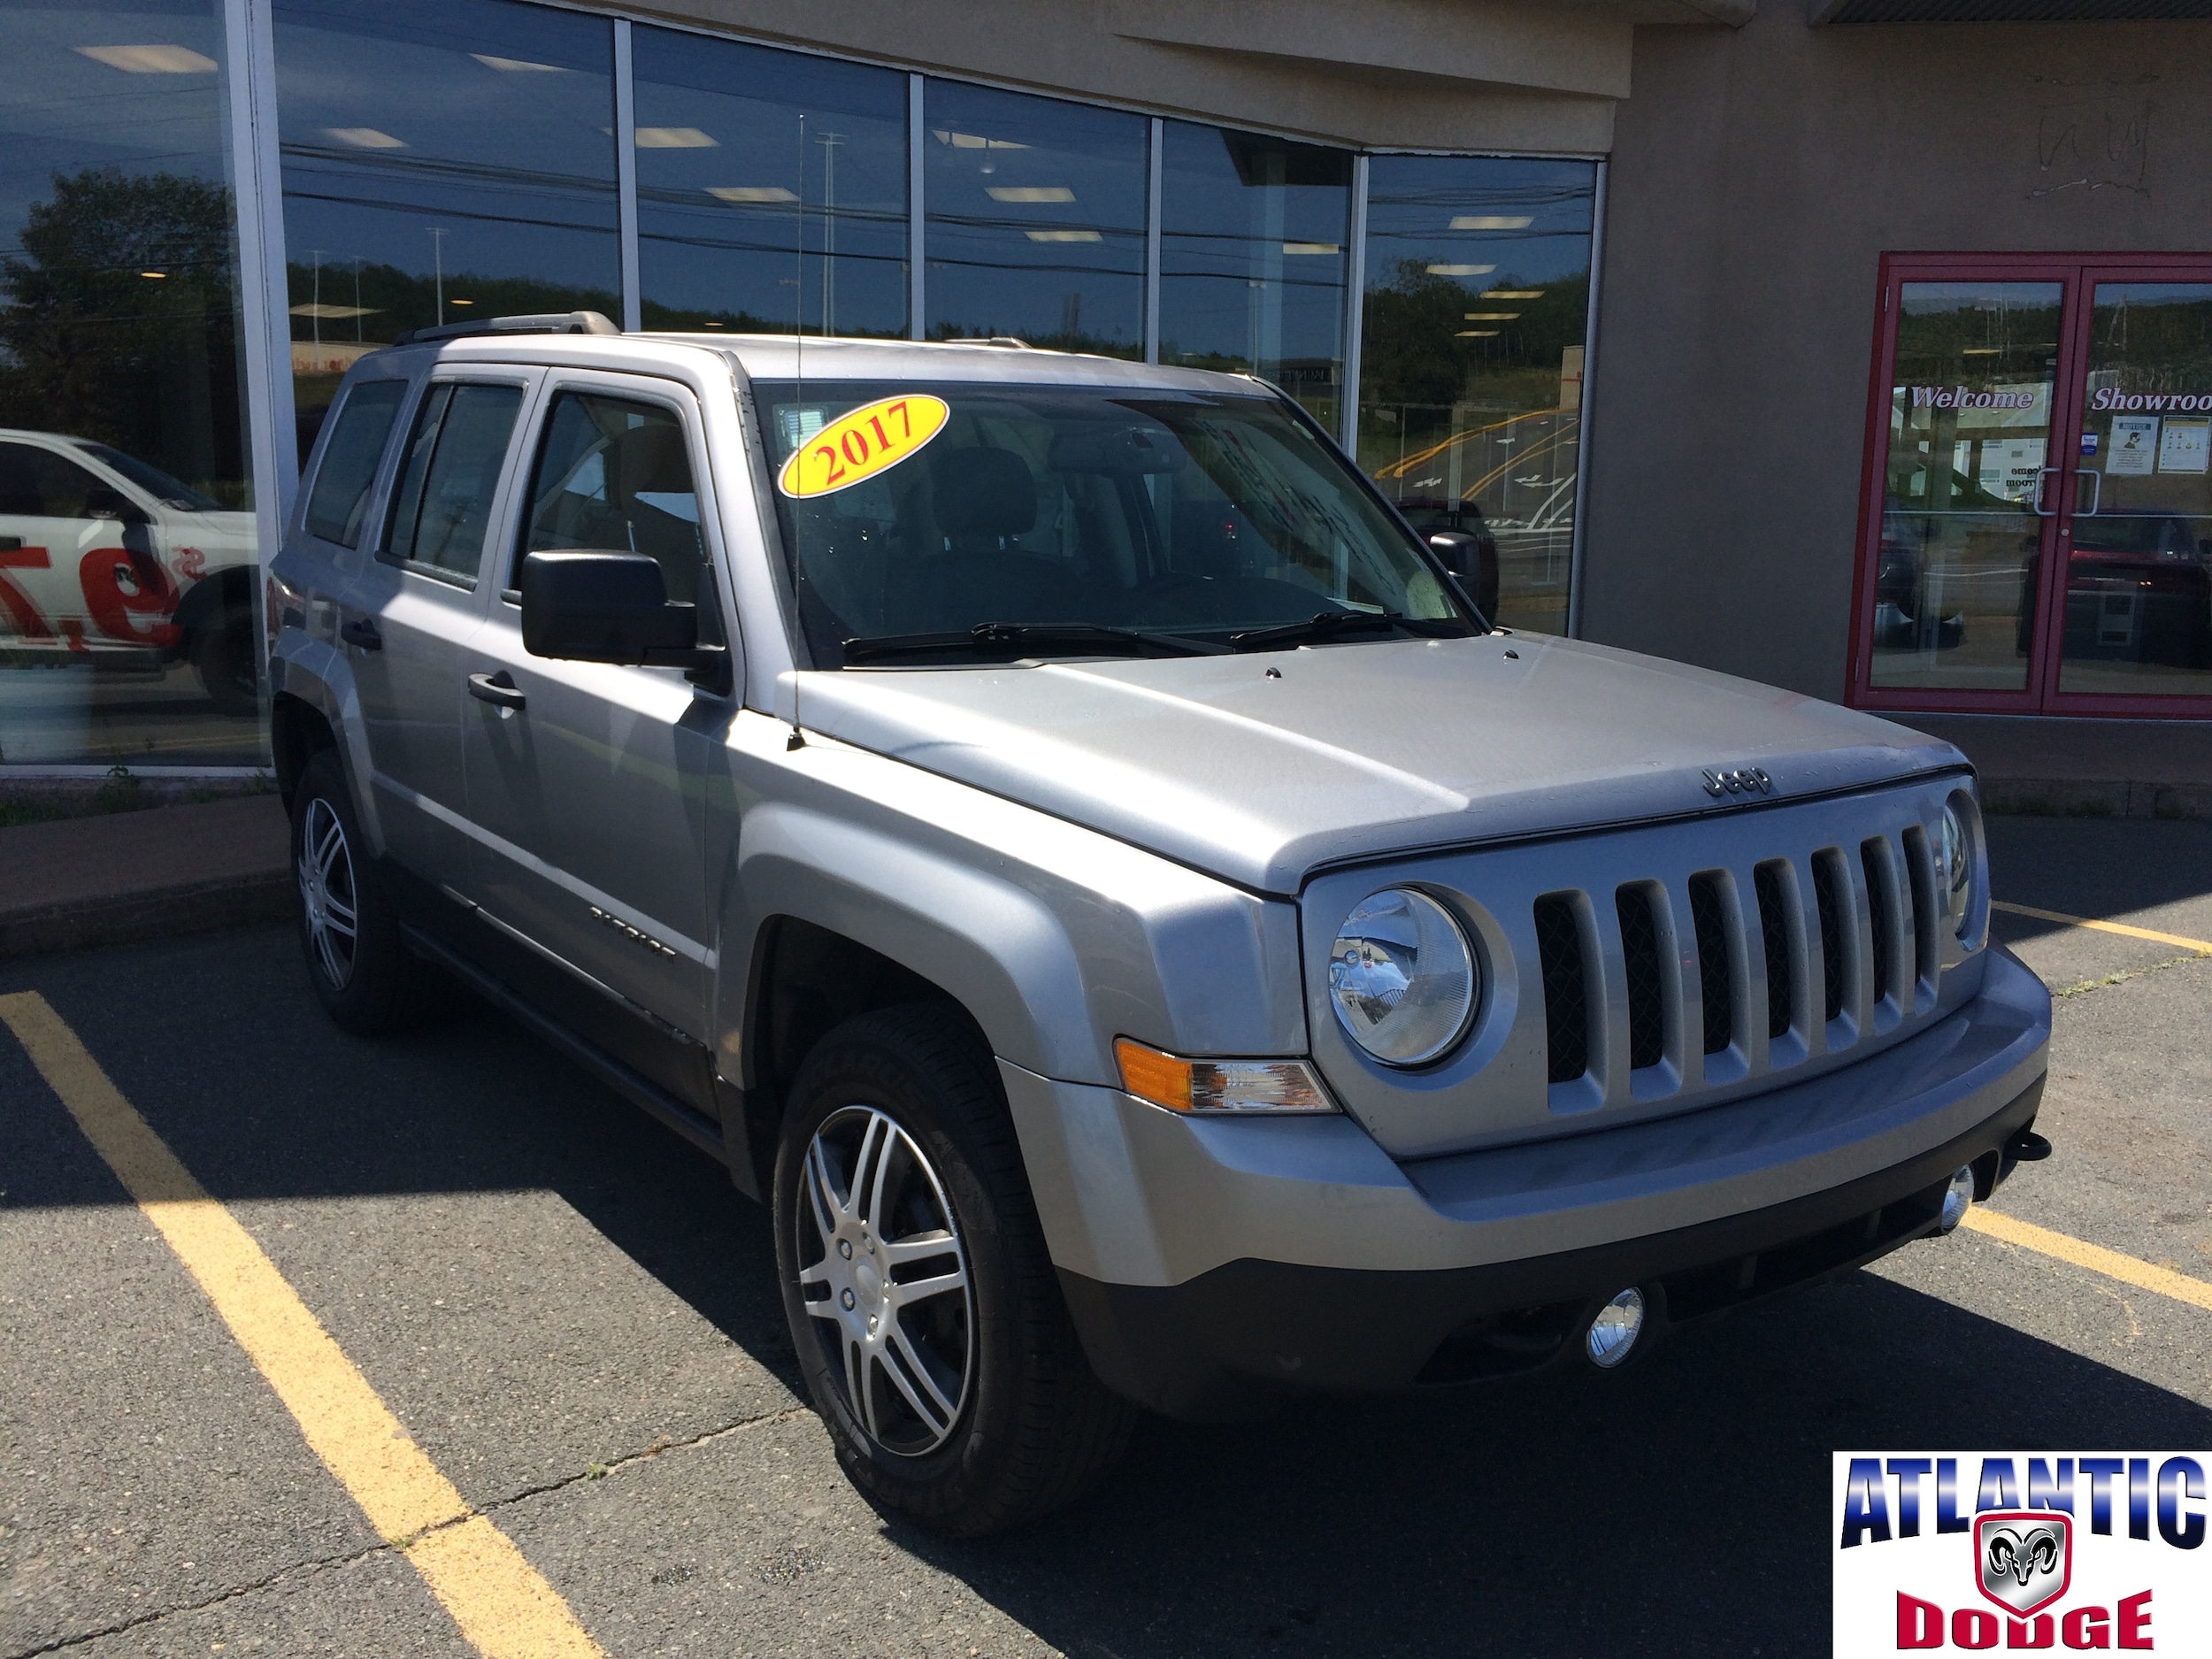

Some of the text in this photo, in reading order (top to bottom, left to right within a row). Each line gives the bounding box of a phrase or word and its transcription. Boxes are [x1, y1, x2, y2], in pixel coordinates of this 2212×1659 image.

[1911, 385, 2034, 409] Welcome
[2091, 387, 2212, 411] Showroo
[814, 401, 910, 486] 2017
[1701, 767, 1772, 797] Jeep
